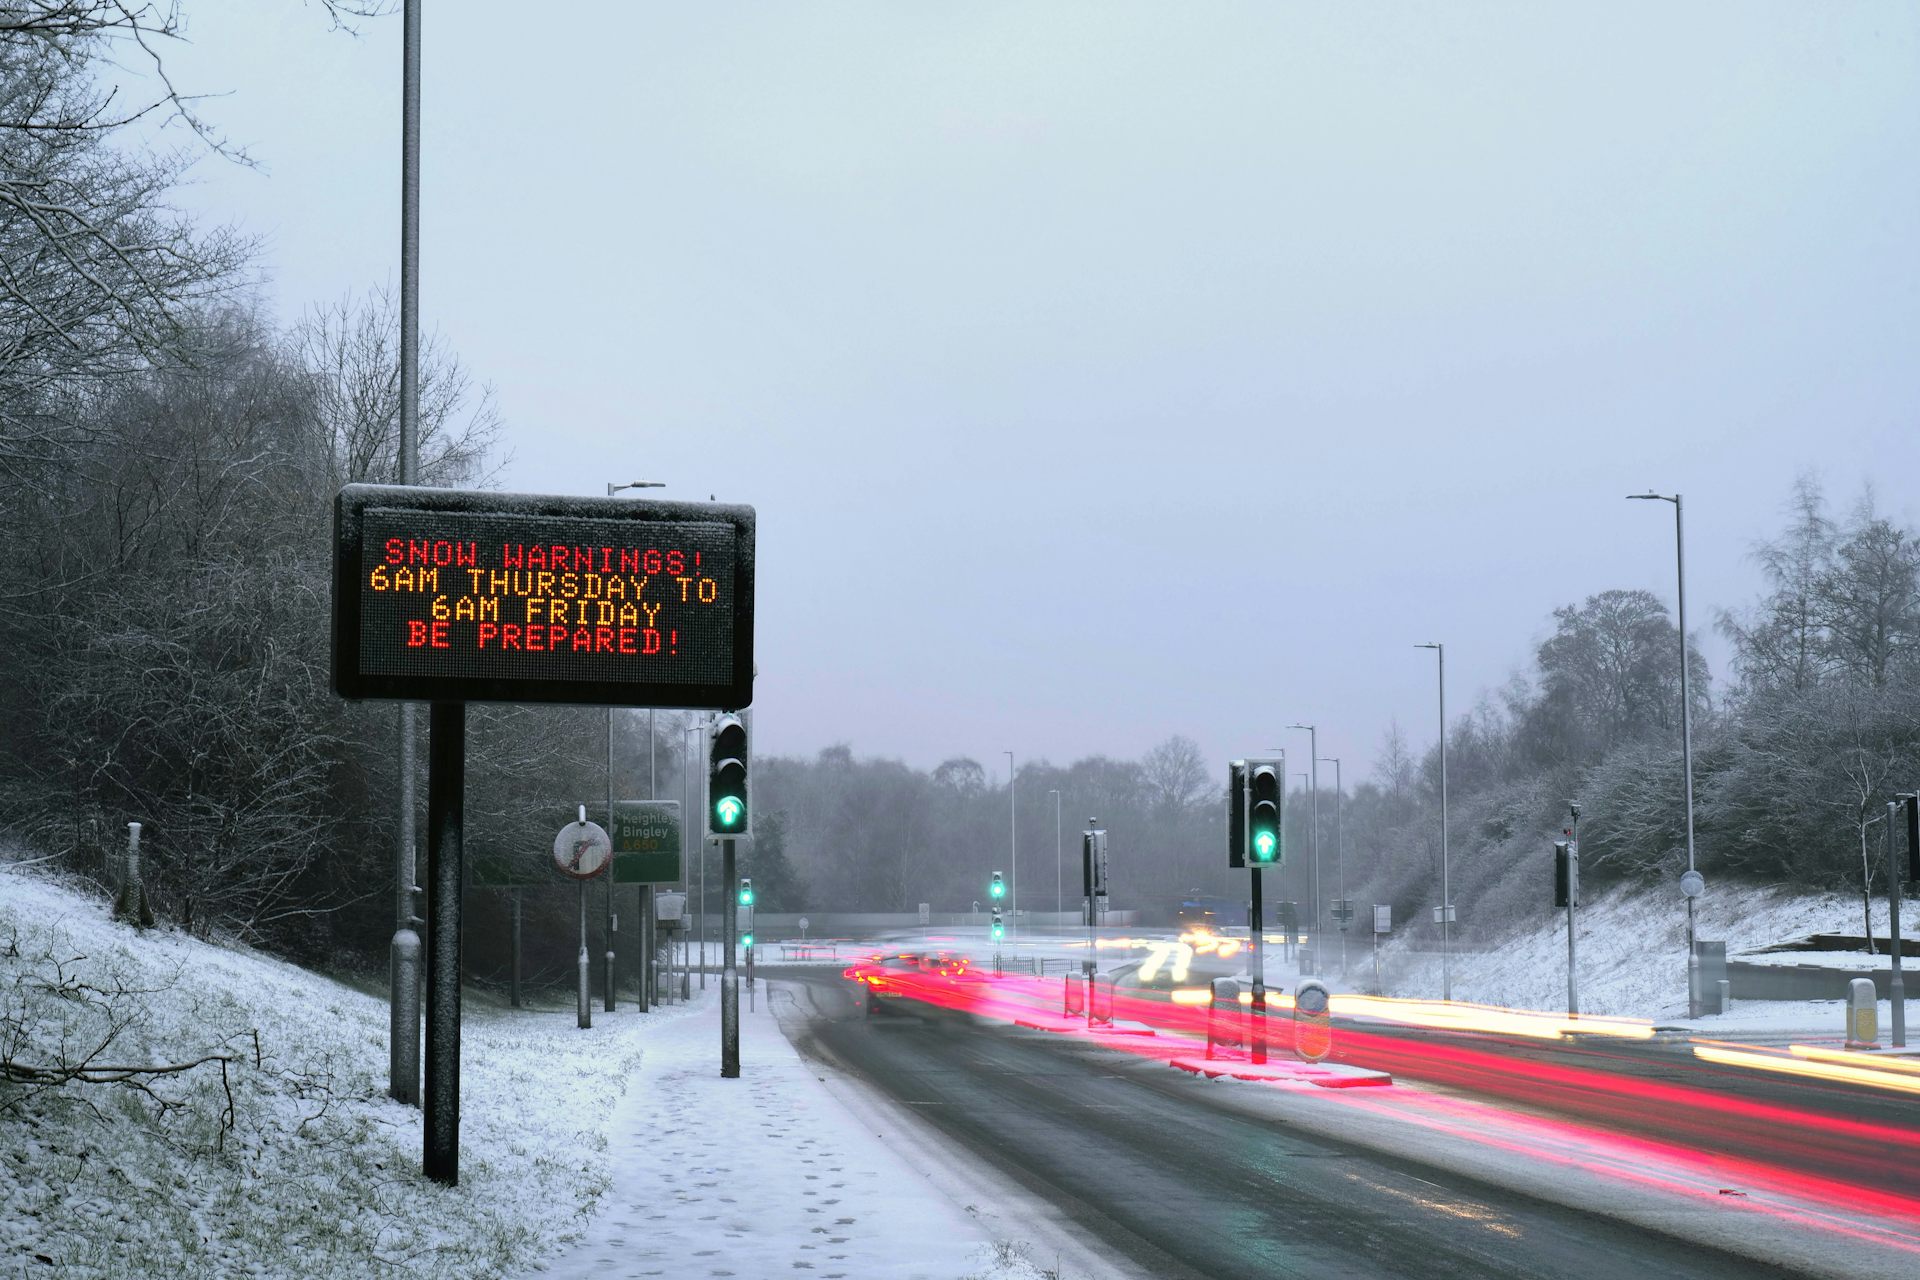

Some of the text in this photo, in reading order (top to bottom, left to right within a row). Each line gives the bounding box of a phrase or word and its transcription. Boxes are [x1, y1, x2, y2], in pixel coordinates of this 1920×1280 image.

[386, 538, 701, 576] SNOW WARNINGS!
[370, 565, 717, 603] 6AM THURSDAY TO
[431, 595, 661, 628] 6AM FRIDAY
[407, 620, 678, 654] BE PREPARED!
[623, 826, 668, 838] Bingley
